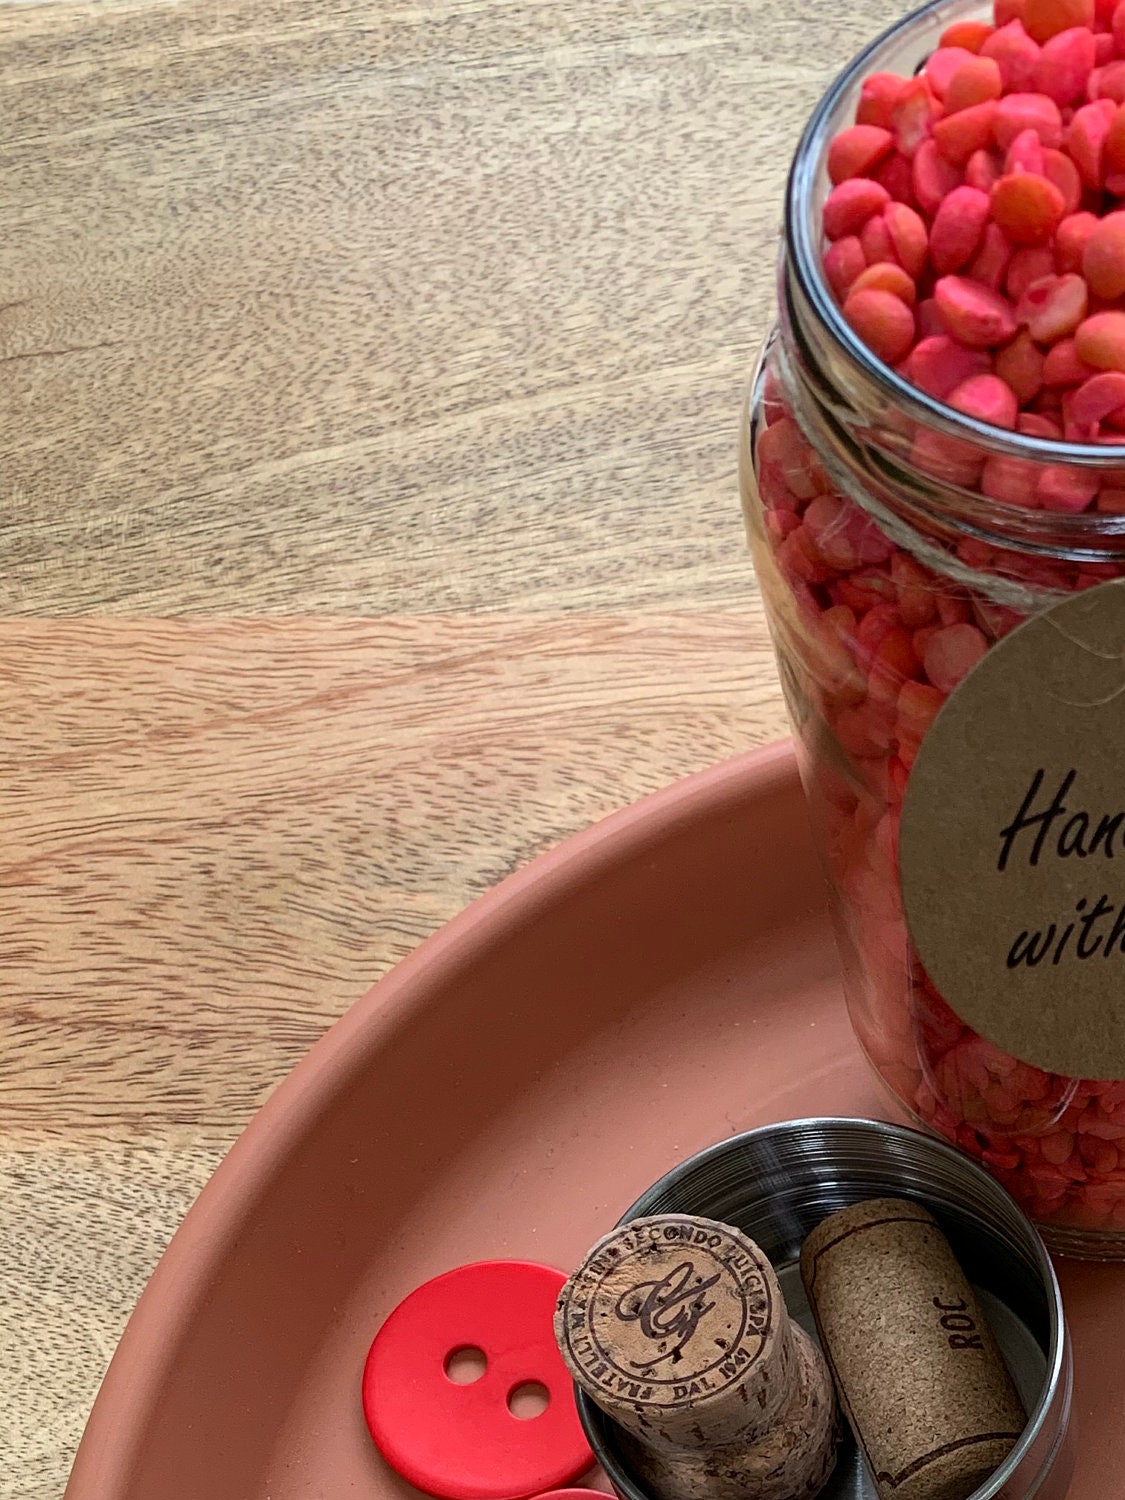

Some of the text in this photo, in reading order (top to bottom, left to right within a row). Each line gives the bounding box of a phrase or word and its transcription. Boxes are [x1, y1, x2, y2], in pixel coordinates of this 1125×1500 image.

[572, 1335, 653, 1400] FRATELLI
[622, 1225, 722, 1251] SECONDO
[933, 1294, 985, 1350] ROC
[673, 1376, 716, 1400] DAL
